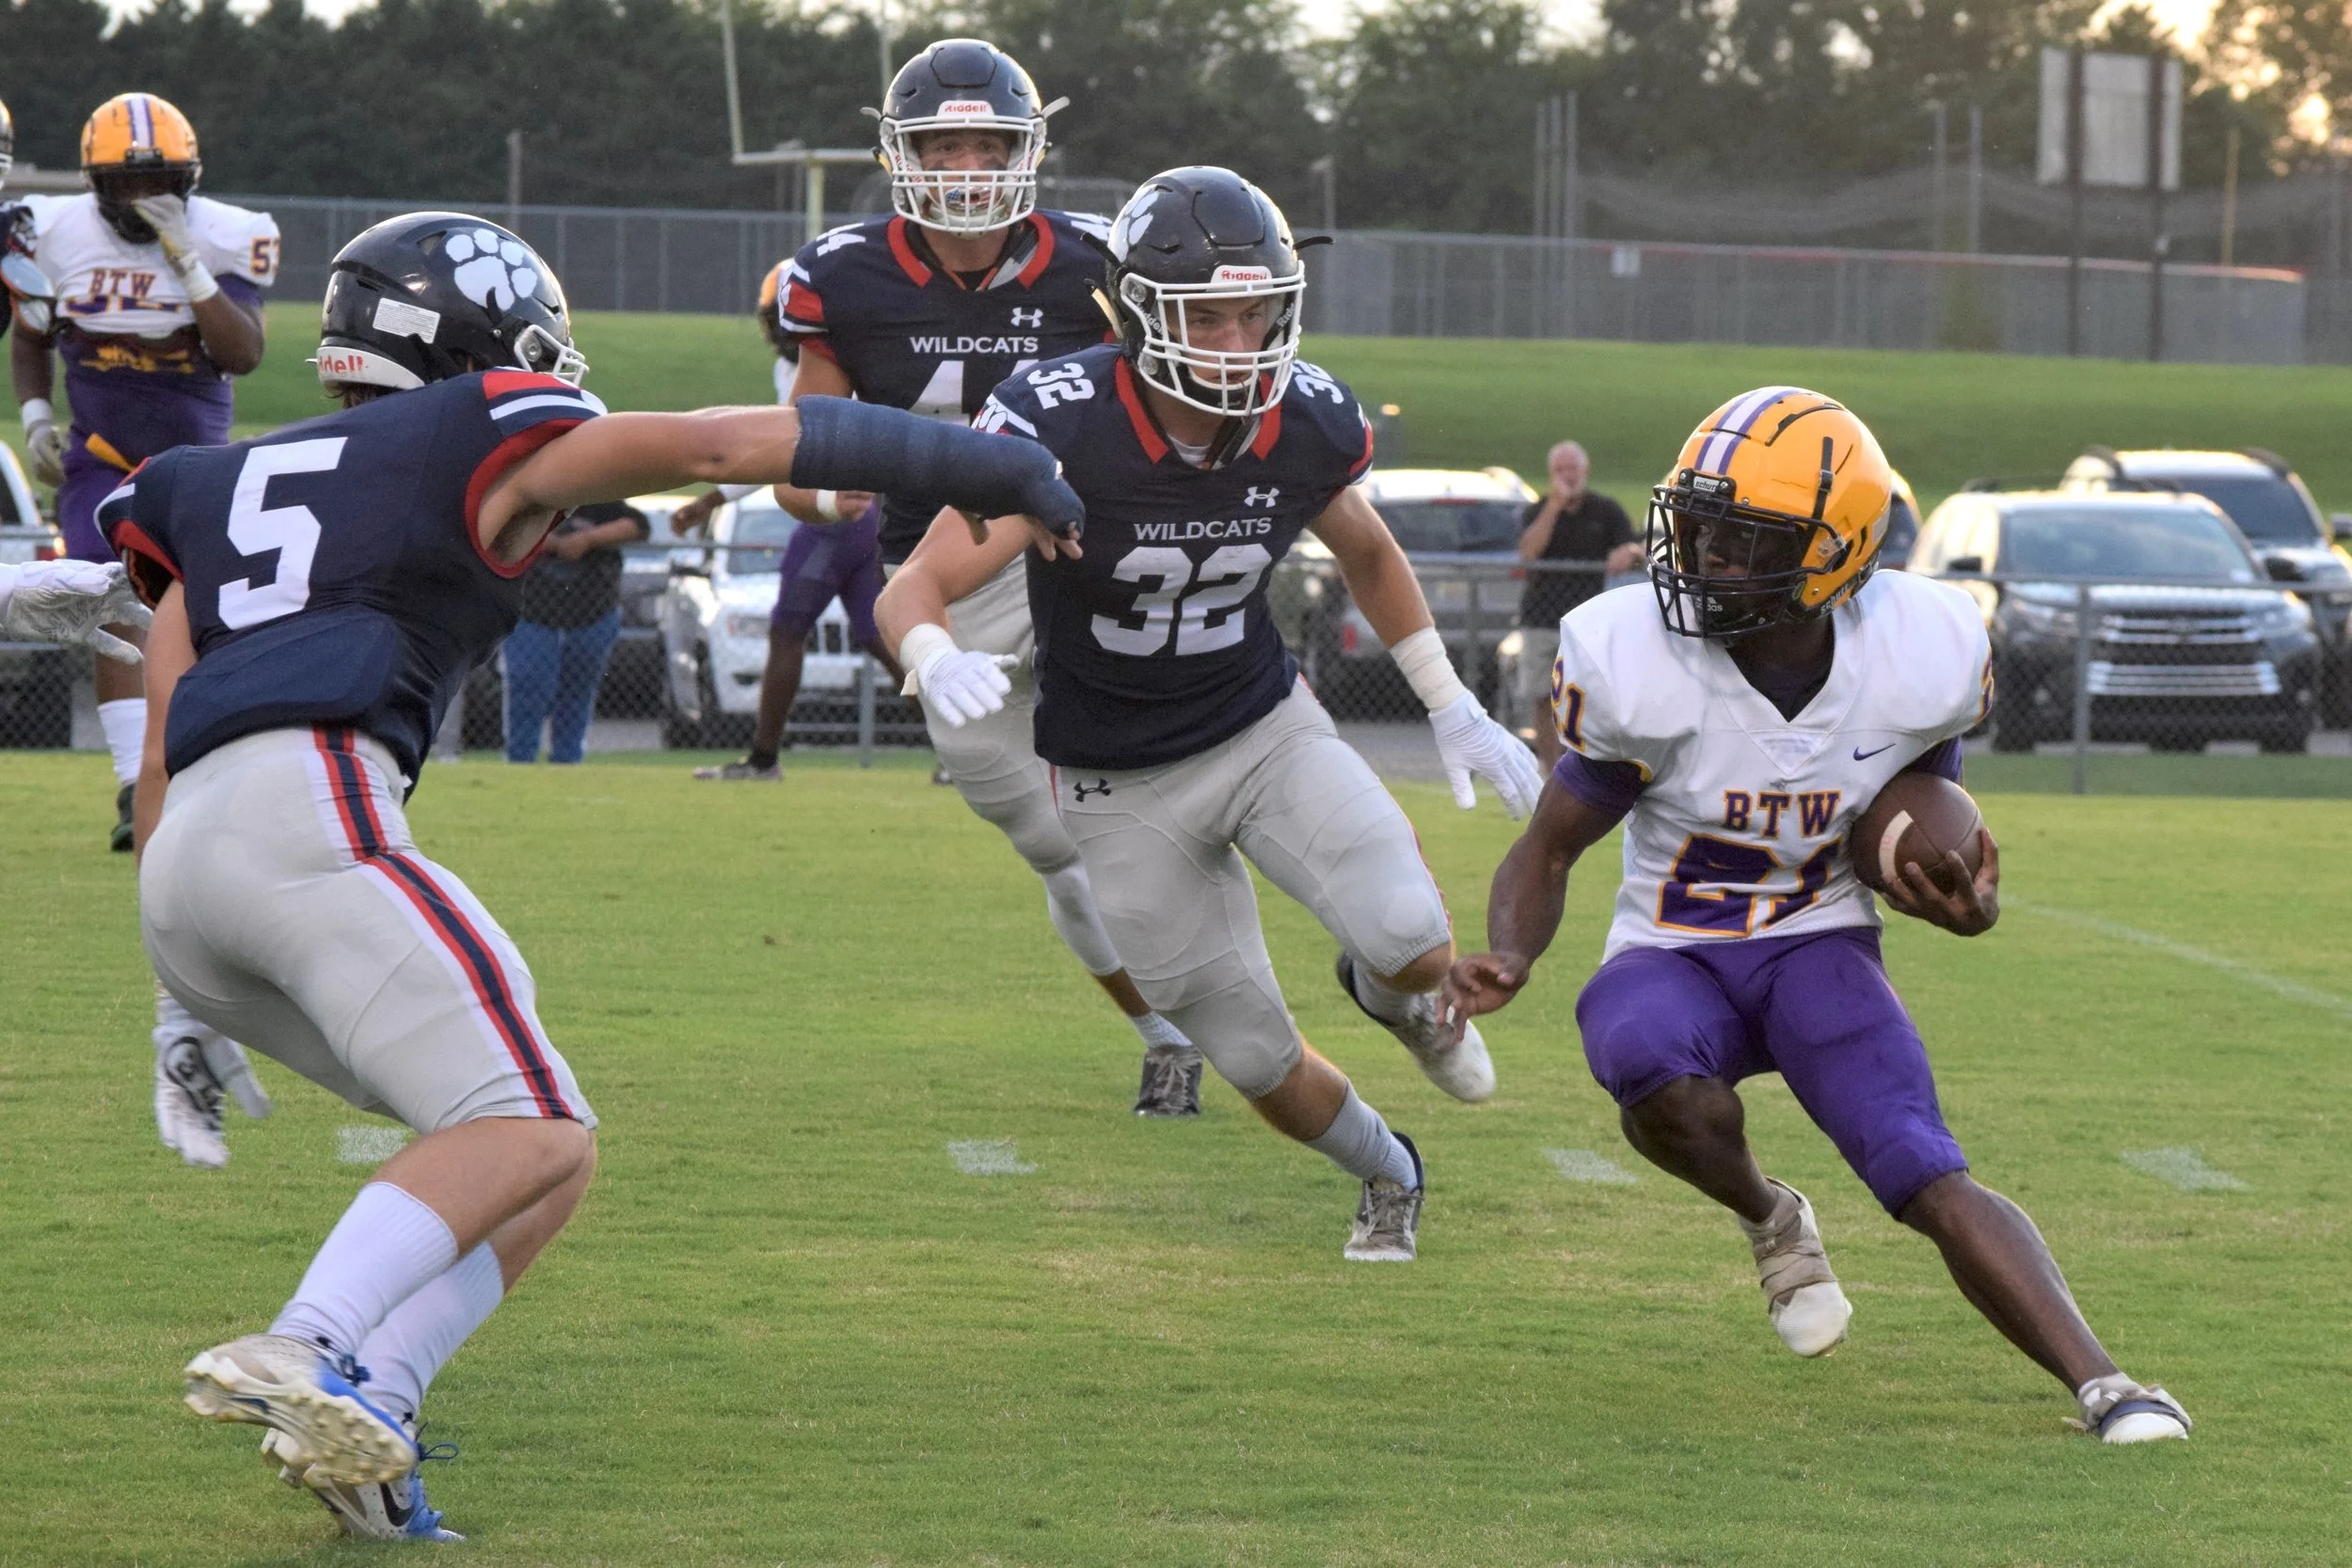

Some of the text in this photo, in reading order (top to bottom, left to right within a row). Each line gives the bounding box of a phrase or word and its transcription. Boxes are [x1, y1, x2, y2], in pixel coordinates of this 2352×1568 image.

[89, 267, 156, 299] BTW
[909, 336, 1039, 354] WILDCATS
[1026, 362, 1096, 410] 32
[1695, 481, 1717, 492] schut
[218, 436, 348, 630] 5
[1133, 517, 1272, 541] WILDCATS
[1090, 543, 1273, 657] 32
[1694, 601, 1724, 612] adas
[1723, 789, 1842, 839] BTW
[1655, 831, 1843, 938] 21
